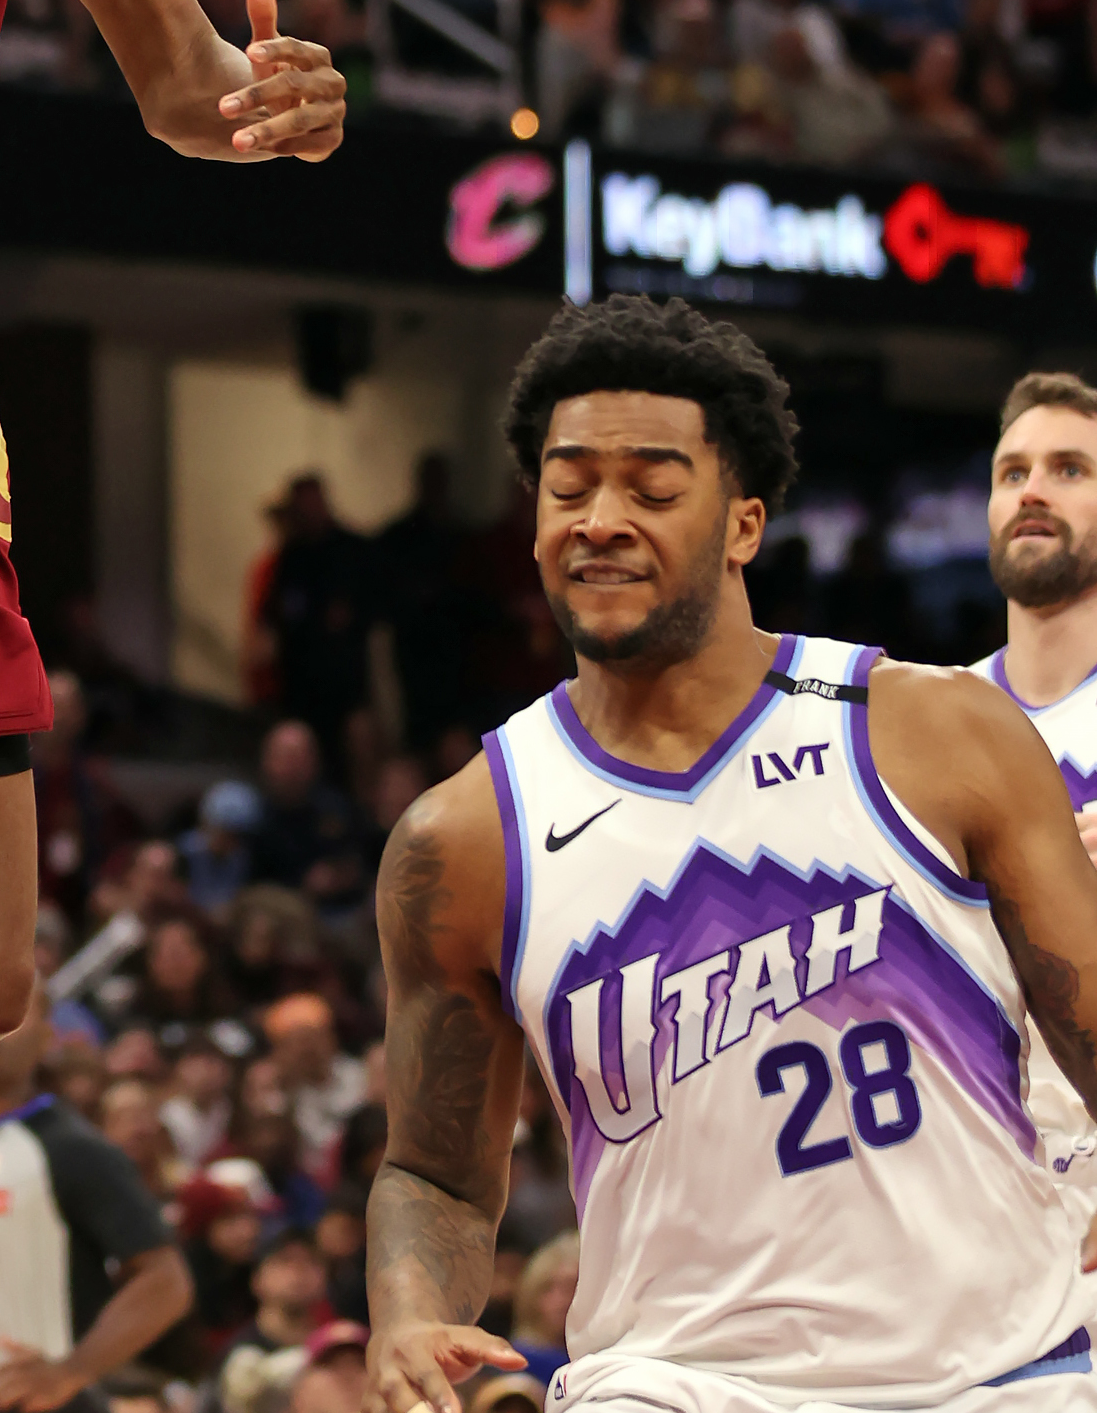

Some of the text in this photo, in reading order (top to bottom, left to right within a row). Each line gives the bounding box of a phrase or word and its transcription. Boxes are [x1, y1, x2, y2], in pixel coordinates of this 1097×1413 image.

[604, 173, 886, 279] KeyBank
[793, 679, 839, 699] FRANK
[752, 741, 830, 789] LVT
[565, 885, 893, 1143] UTAH
[755, 1021, 921, 1178] 28
